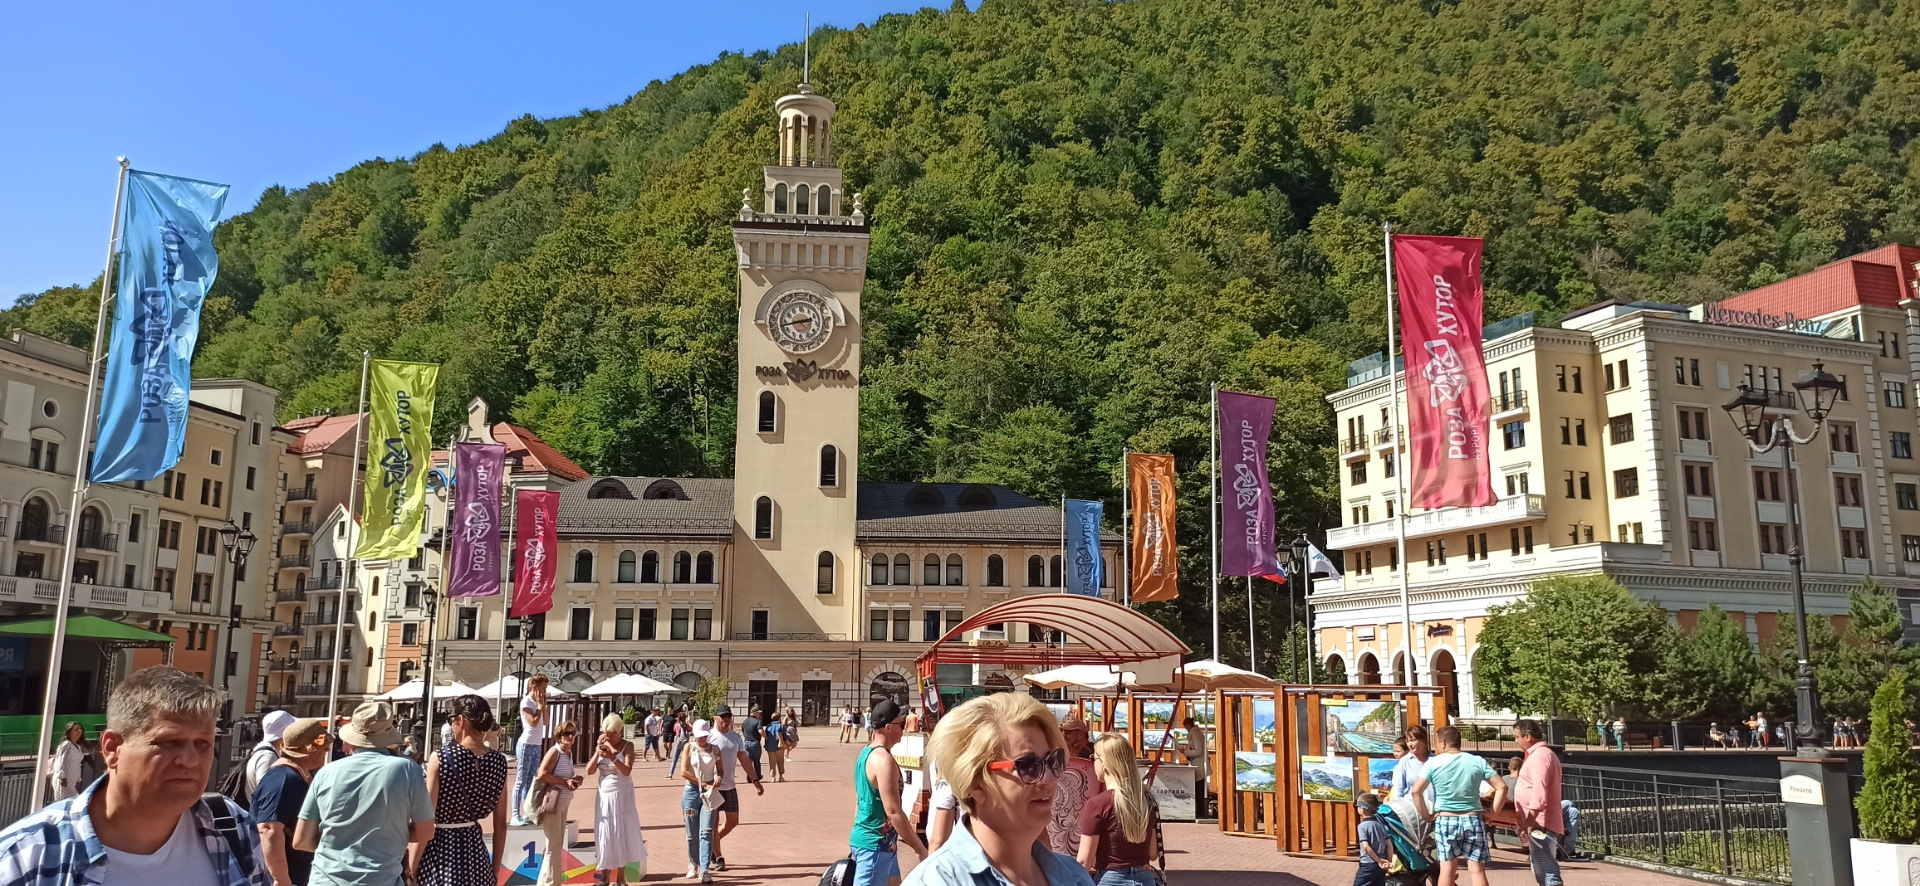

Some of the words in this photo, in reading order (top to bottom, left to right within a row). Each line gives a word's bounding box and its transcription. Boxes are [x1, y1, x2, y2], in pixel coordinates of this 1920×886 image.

[1433, 274, 1458, 336] ХУТОР
[1703, 301, 1824, 335] Mercedes-Benz
[755, 366, 782, 377] РОЗА
[818, 368, 850, 381] ХУТОР
[396, 390, 411, 435] ХУТОР
[1241, 420, 1256, 462] ХУТОР
[1446, 407, 1468, 459] РОЗА
[476, 465, 489, 501] ХУТОР
[1149, 478, 1161, 511] ХУТОР
[391, 486, 407, 526] РОЗА
[534, 507, 545, 537] ХУТОР
[1081, 517, 1092, 546] ХУТОР
[1246, 509, 1259, 545] РОЗА
[472, 541, 487, 571] РОЗА
[1153, 546, 1163, 576] РОЗА
[530, 569, 542, 595] РОЗА
[1082, 577, 1093, 596] ОЗА
[565, 660, 646, 672] LUCIANO
[522, 841, 538, 868] 1
